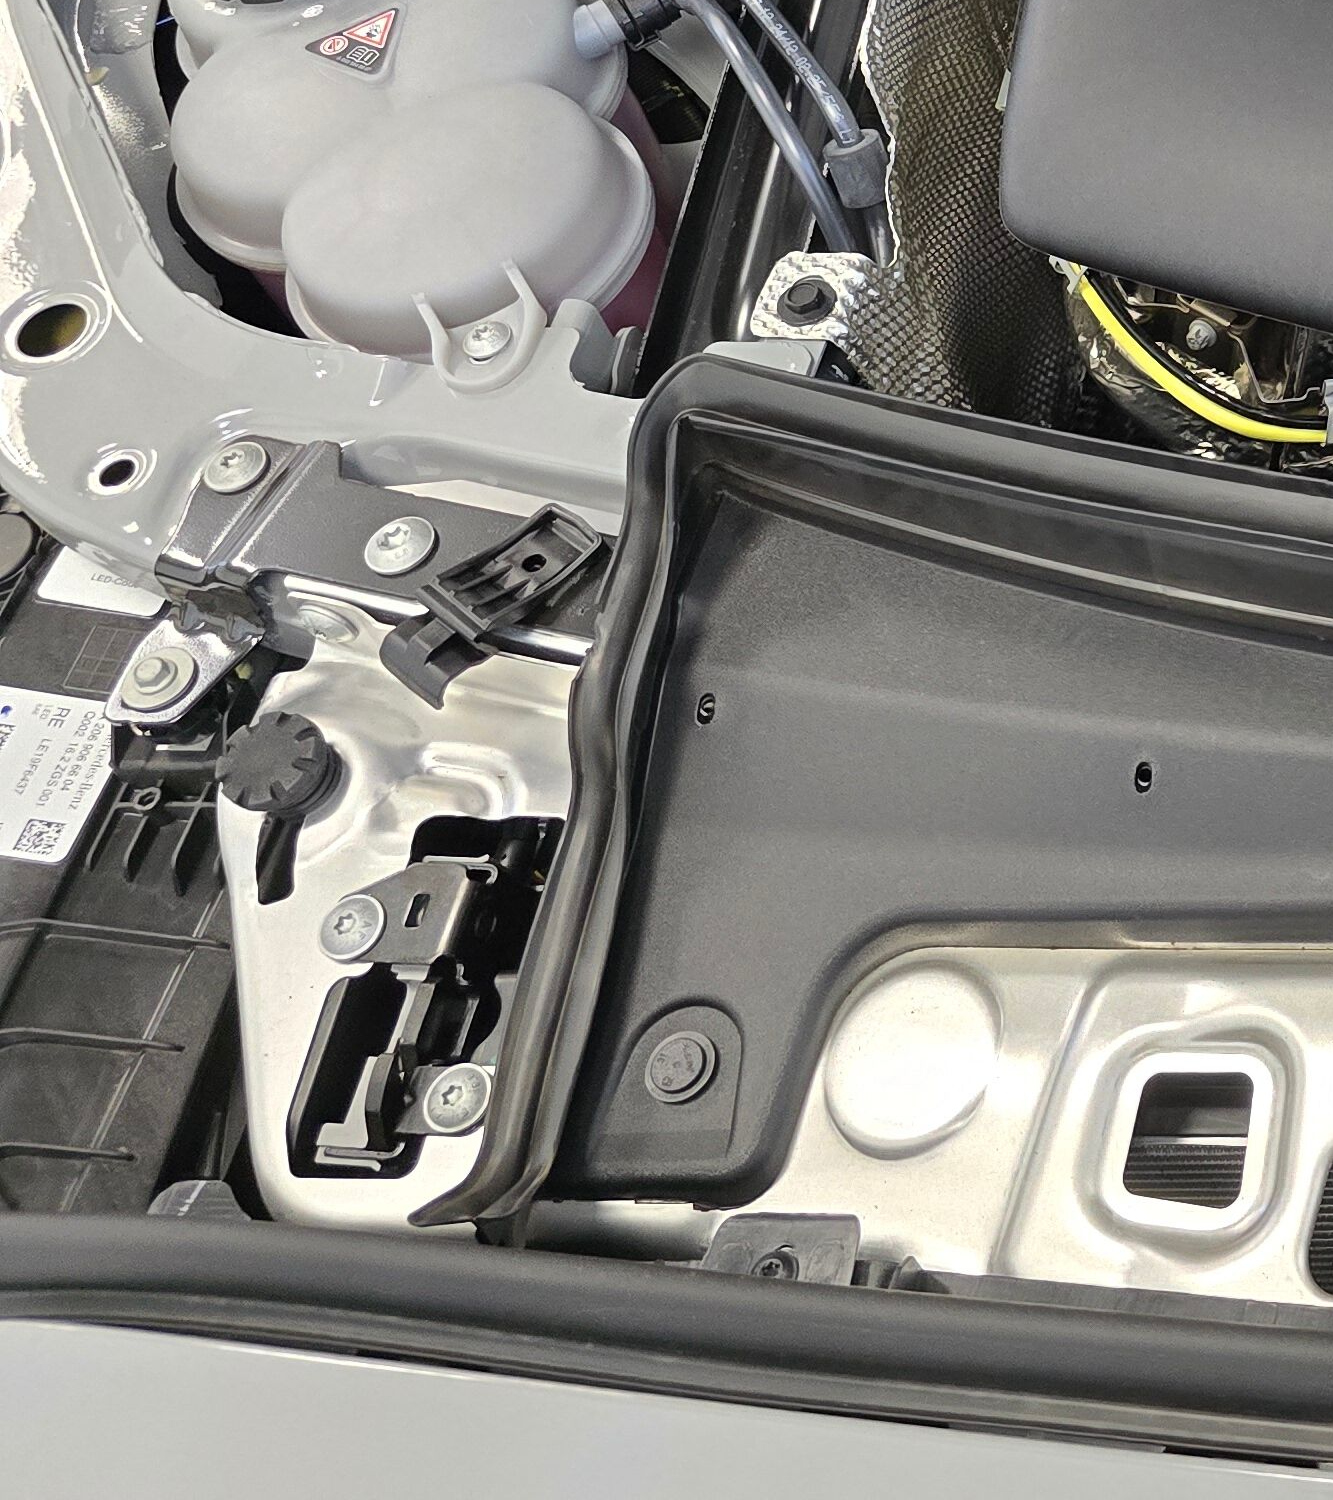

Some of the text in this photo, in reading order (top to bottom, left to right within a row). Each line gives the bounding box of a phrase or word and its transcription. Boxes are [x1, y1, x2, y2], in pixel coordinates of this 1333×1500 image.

[48, 707, 71, 729] RE
[88, 723, 105, 741] 206
[76, 744, 93, 762] 906
